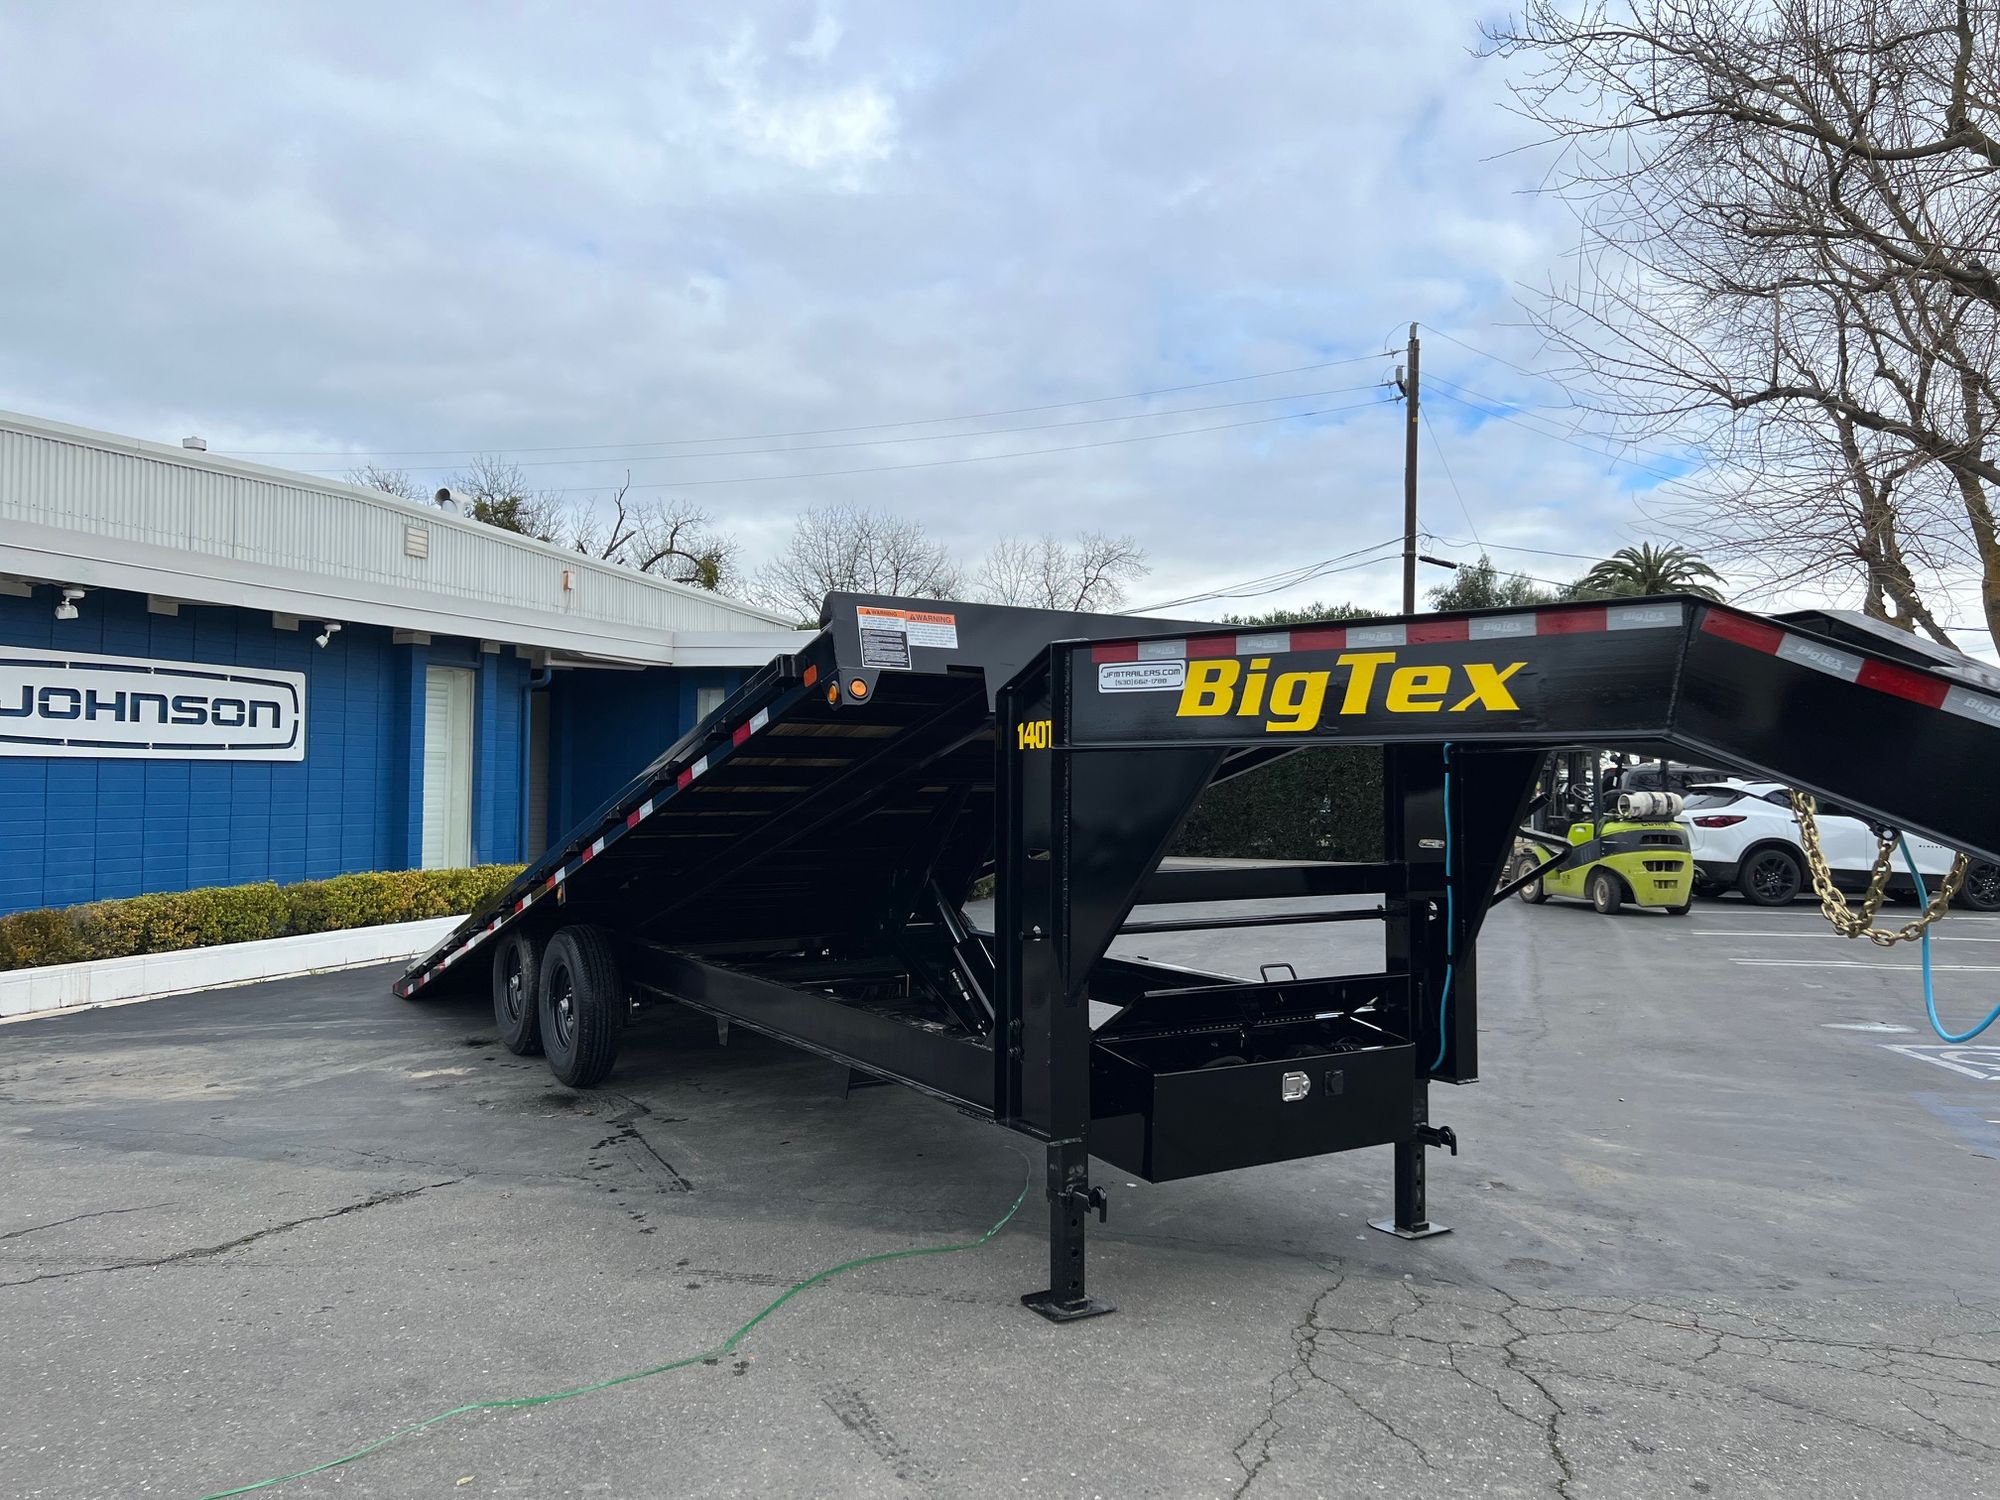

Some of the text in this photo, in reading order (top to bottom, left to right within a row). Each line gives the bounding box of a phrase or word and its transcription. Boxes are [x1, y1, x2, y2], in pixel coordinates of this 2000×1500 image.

[916, 614, 951, 624] WARNING
[1103, 668, 1181, 678] JFMTRAILERS.COM
[1176, 652, 1528, 732] BigTex
[0, 685, 281, 729] JOHNSON
